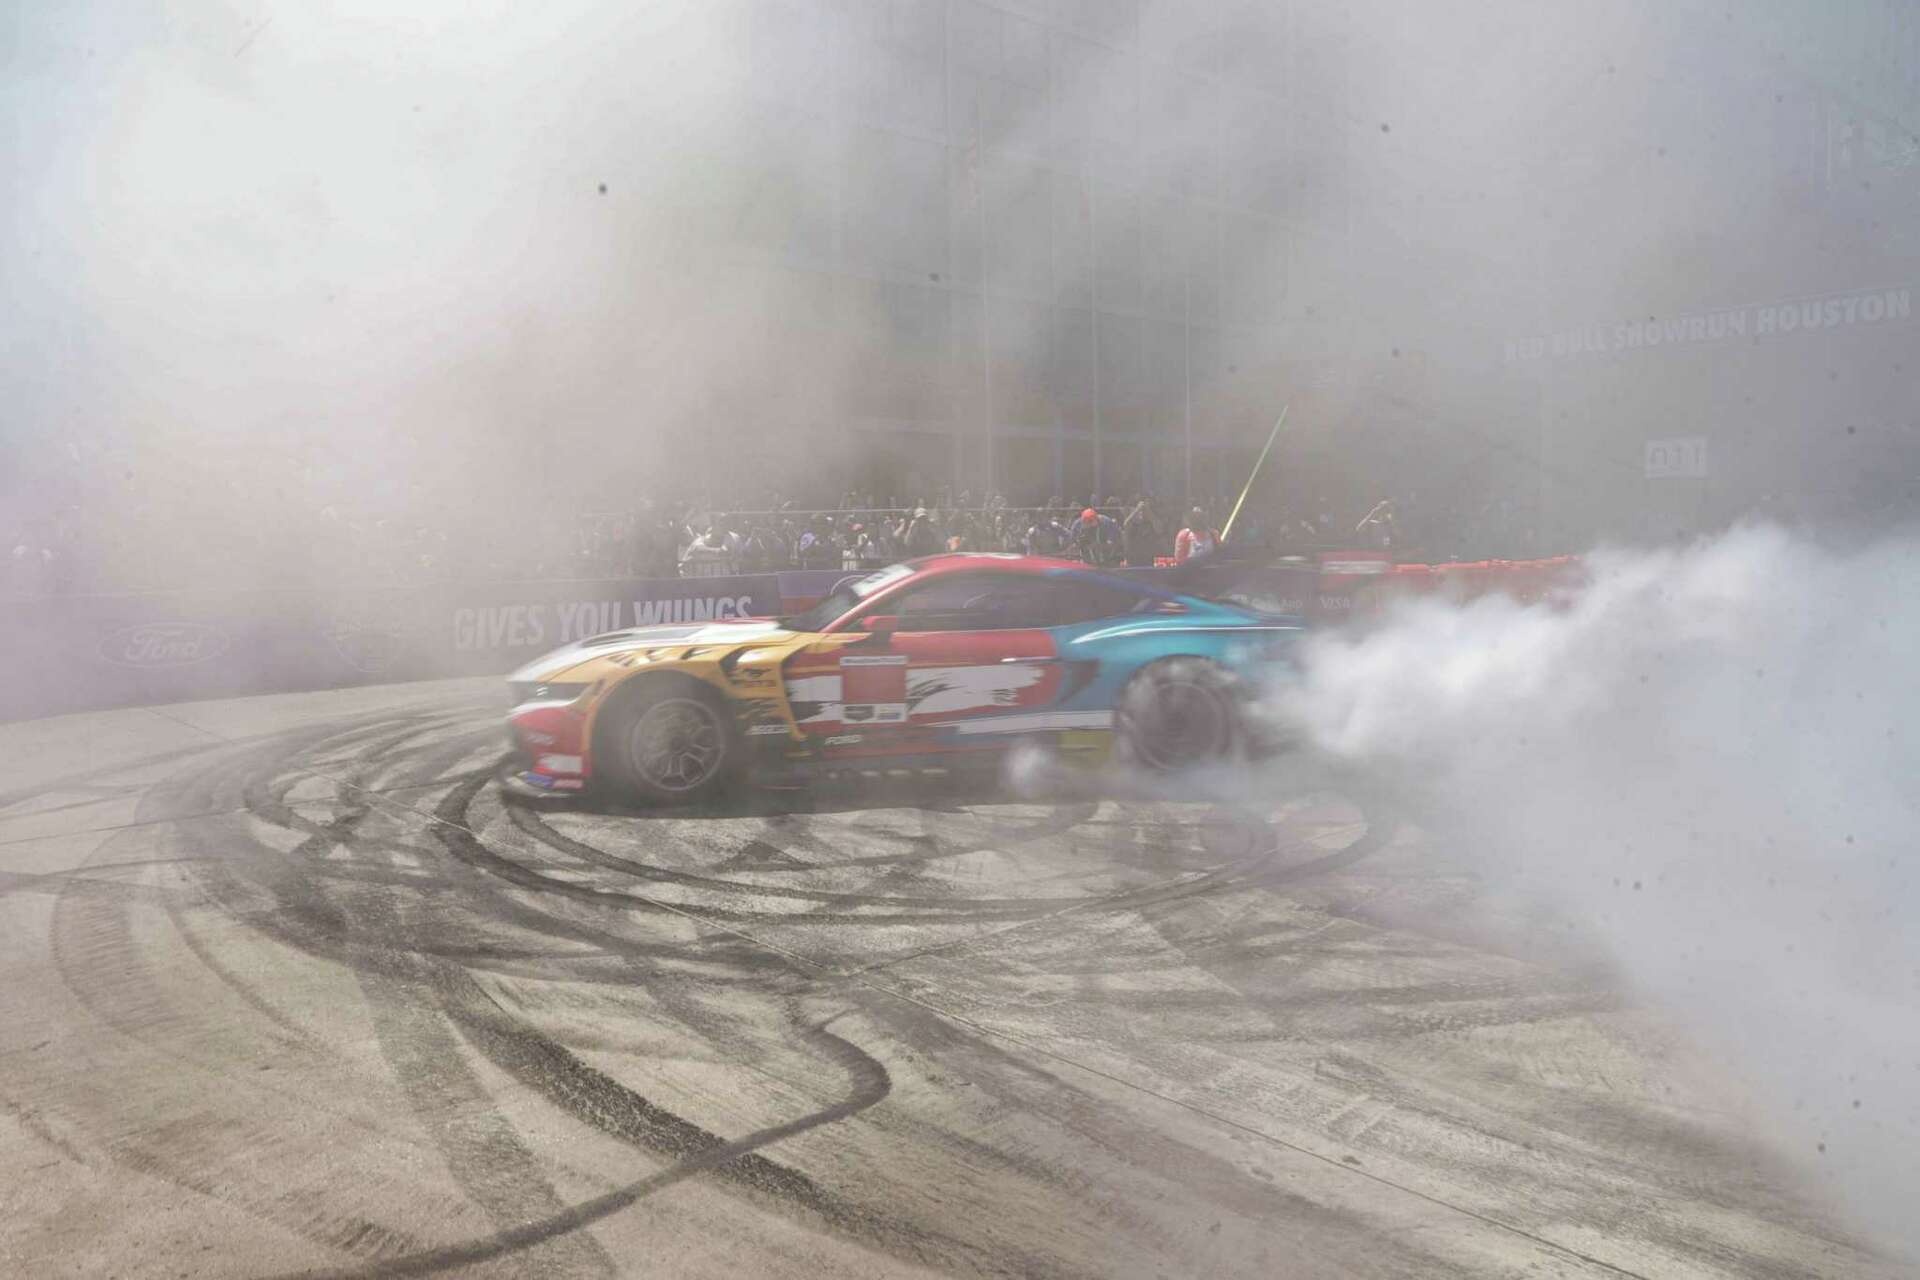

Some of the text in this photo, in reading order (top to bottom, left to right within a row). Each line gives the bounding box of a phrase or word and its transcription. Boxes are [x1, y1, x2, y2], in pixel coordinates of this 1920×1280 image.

[1756, 287, 1912, 336] HOUSTON
[125, 630, 203, 661] Ford
[455, 604, 544, 650] GIVES
[556, 600, 621, 643] YOU
